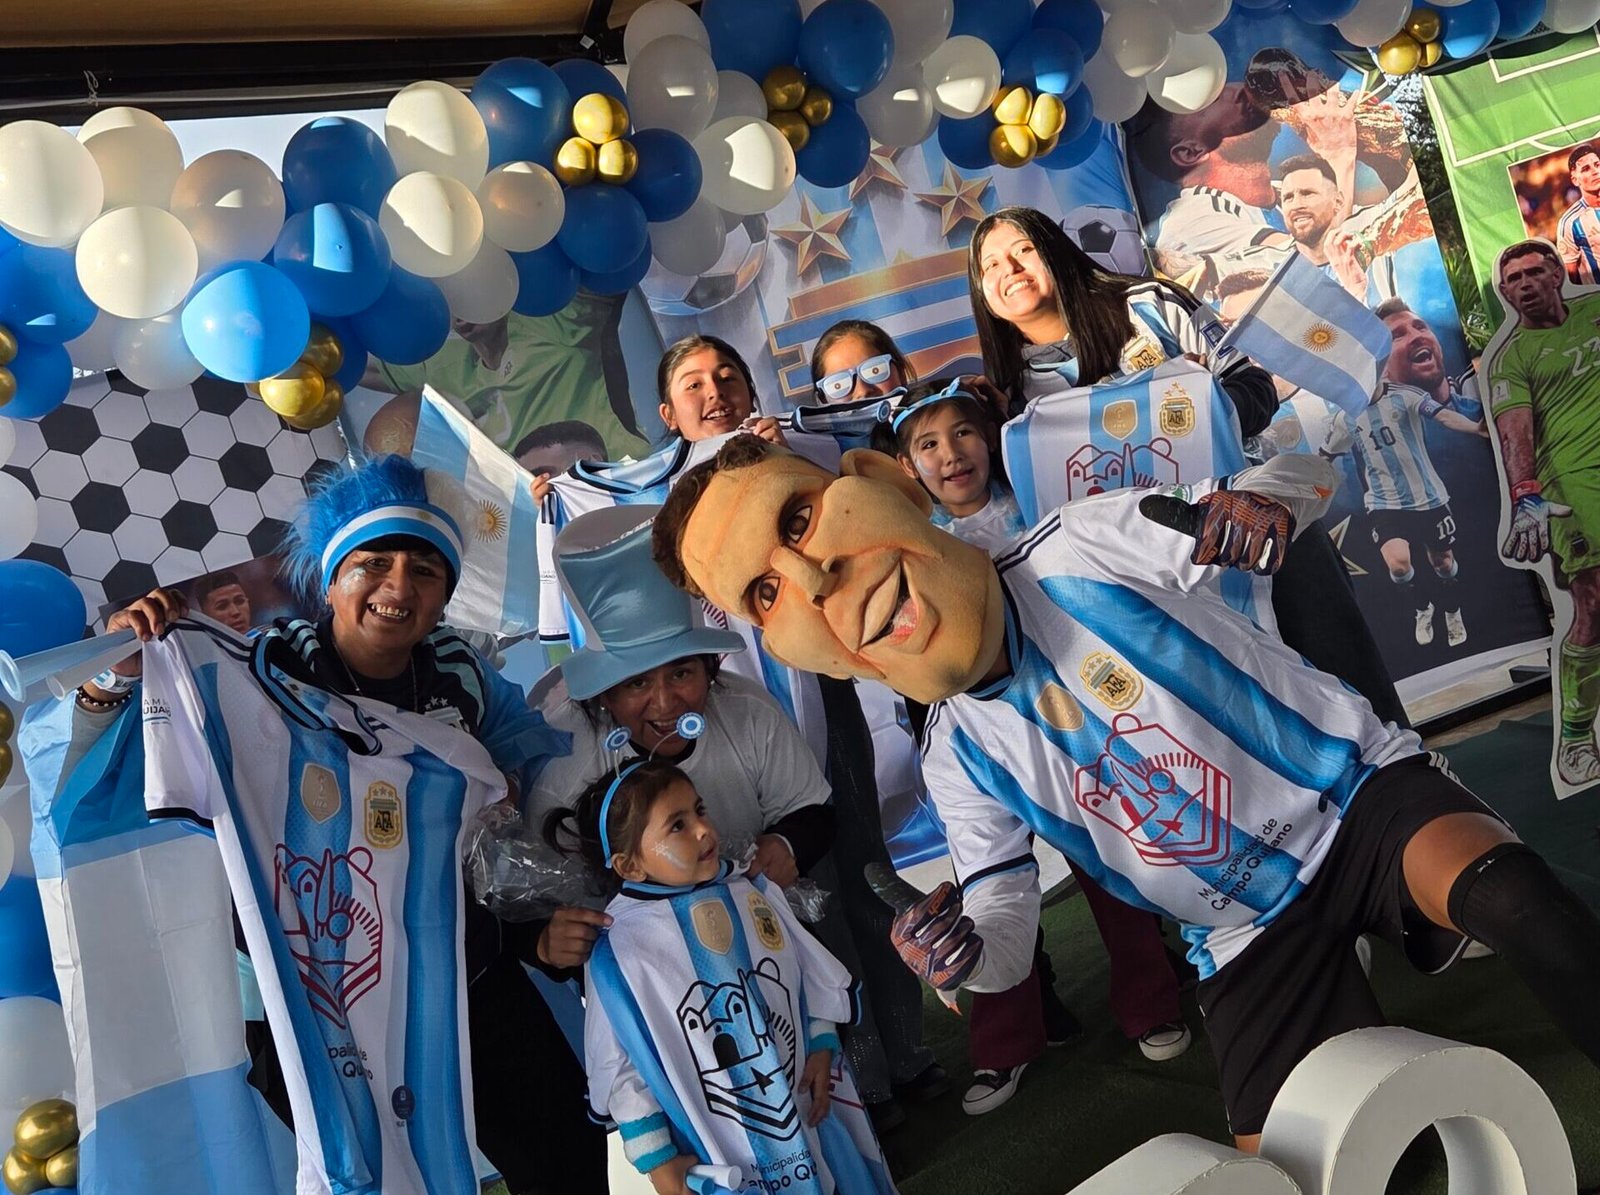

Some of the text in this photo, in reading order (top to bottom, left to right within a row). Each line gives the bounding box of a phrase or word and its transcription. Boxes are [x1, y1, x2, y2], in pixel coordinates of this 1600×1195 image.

[1369, 426, 1396, 451] 10
[1437, 515, 1456, 540] 10
[1262, 818, 1278, 835] de
[1211, 871, 1252, 911] Campo
